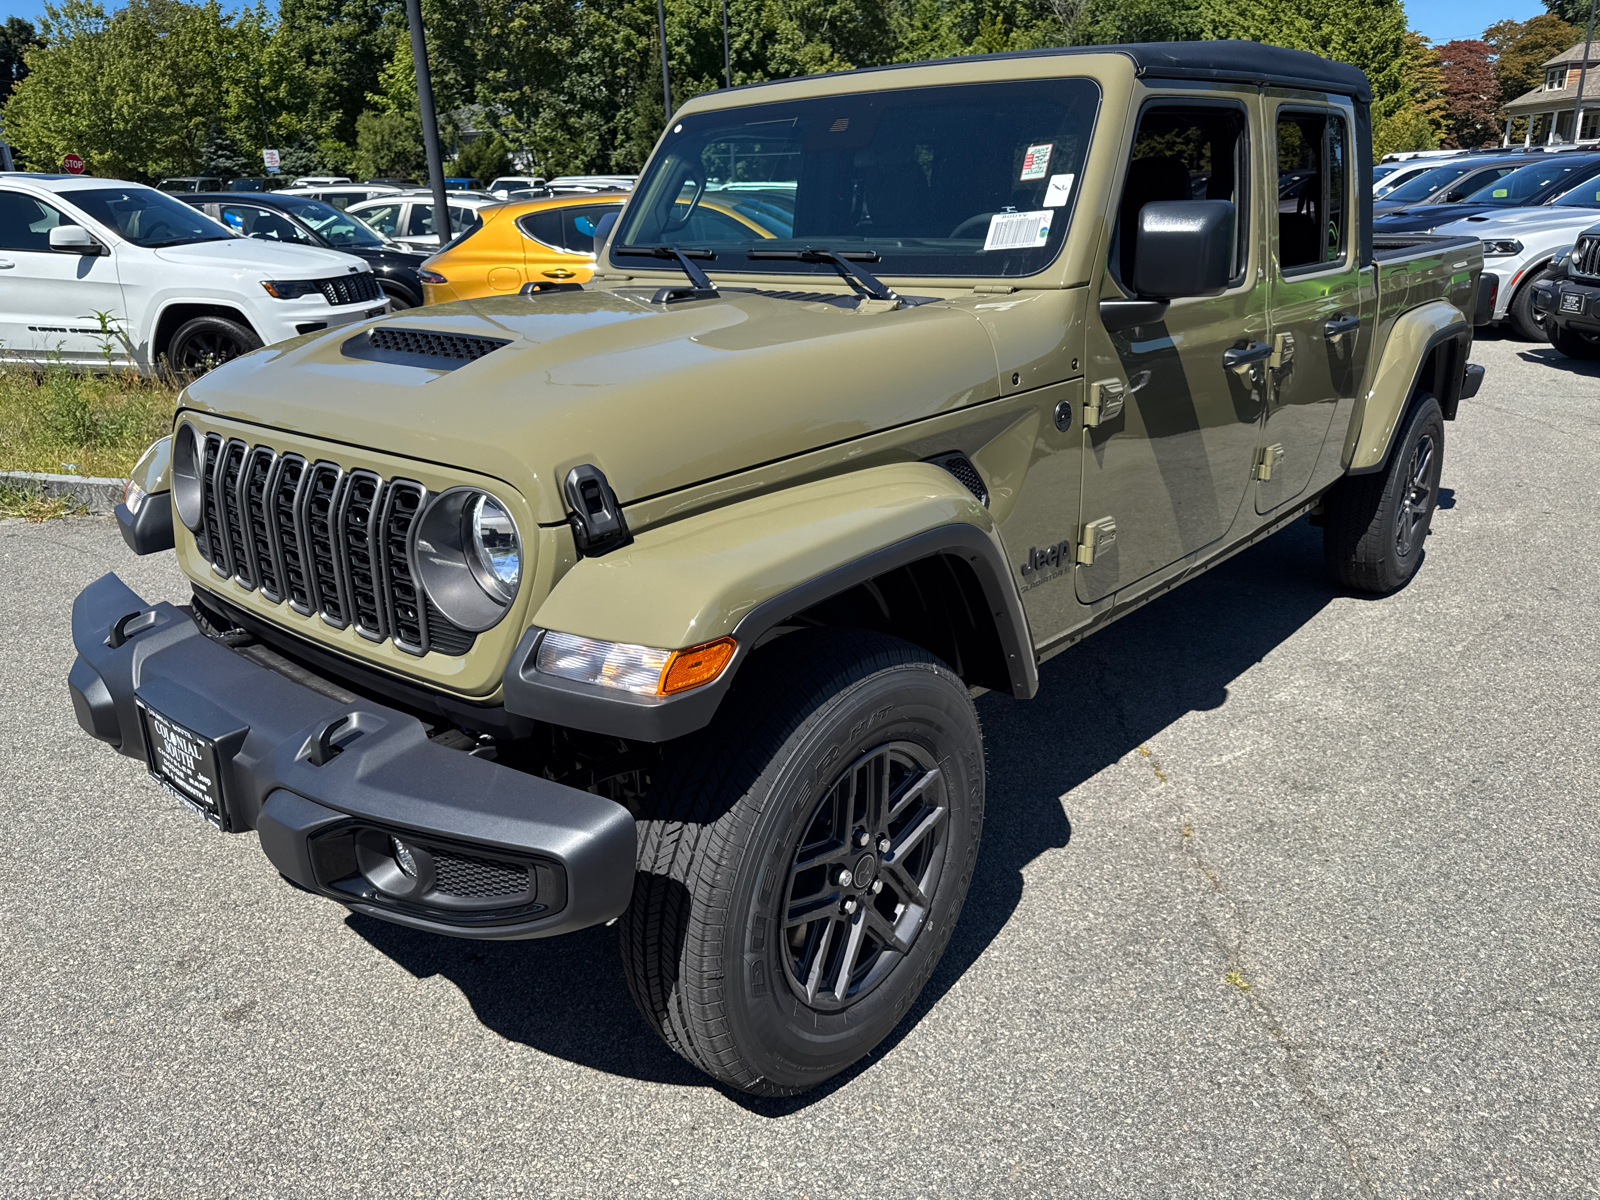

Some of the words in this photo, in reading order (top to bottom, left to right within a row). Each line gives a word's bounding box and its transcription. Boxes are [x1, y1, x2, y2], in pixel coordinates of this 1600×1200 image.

[65, 159, 83, 169] STOP
[1021, 540, 1070, 577] Jeep
[1021, 570, 1063, 594] GLADIATOR
[154, 720, 202, 760] COLONIAL
[164, 739, 195, 770] SOUTH
[750, 742, 841, 998] DUELER
[848, 703, 895, 745] H/T
